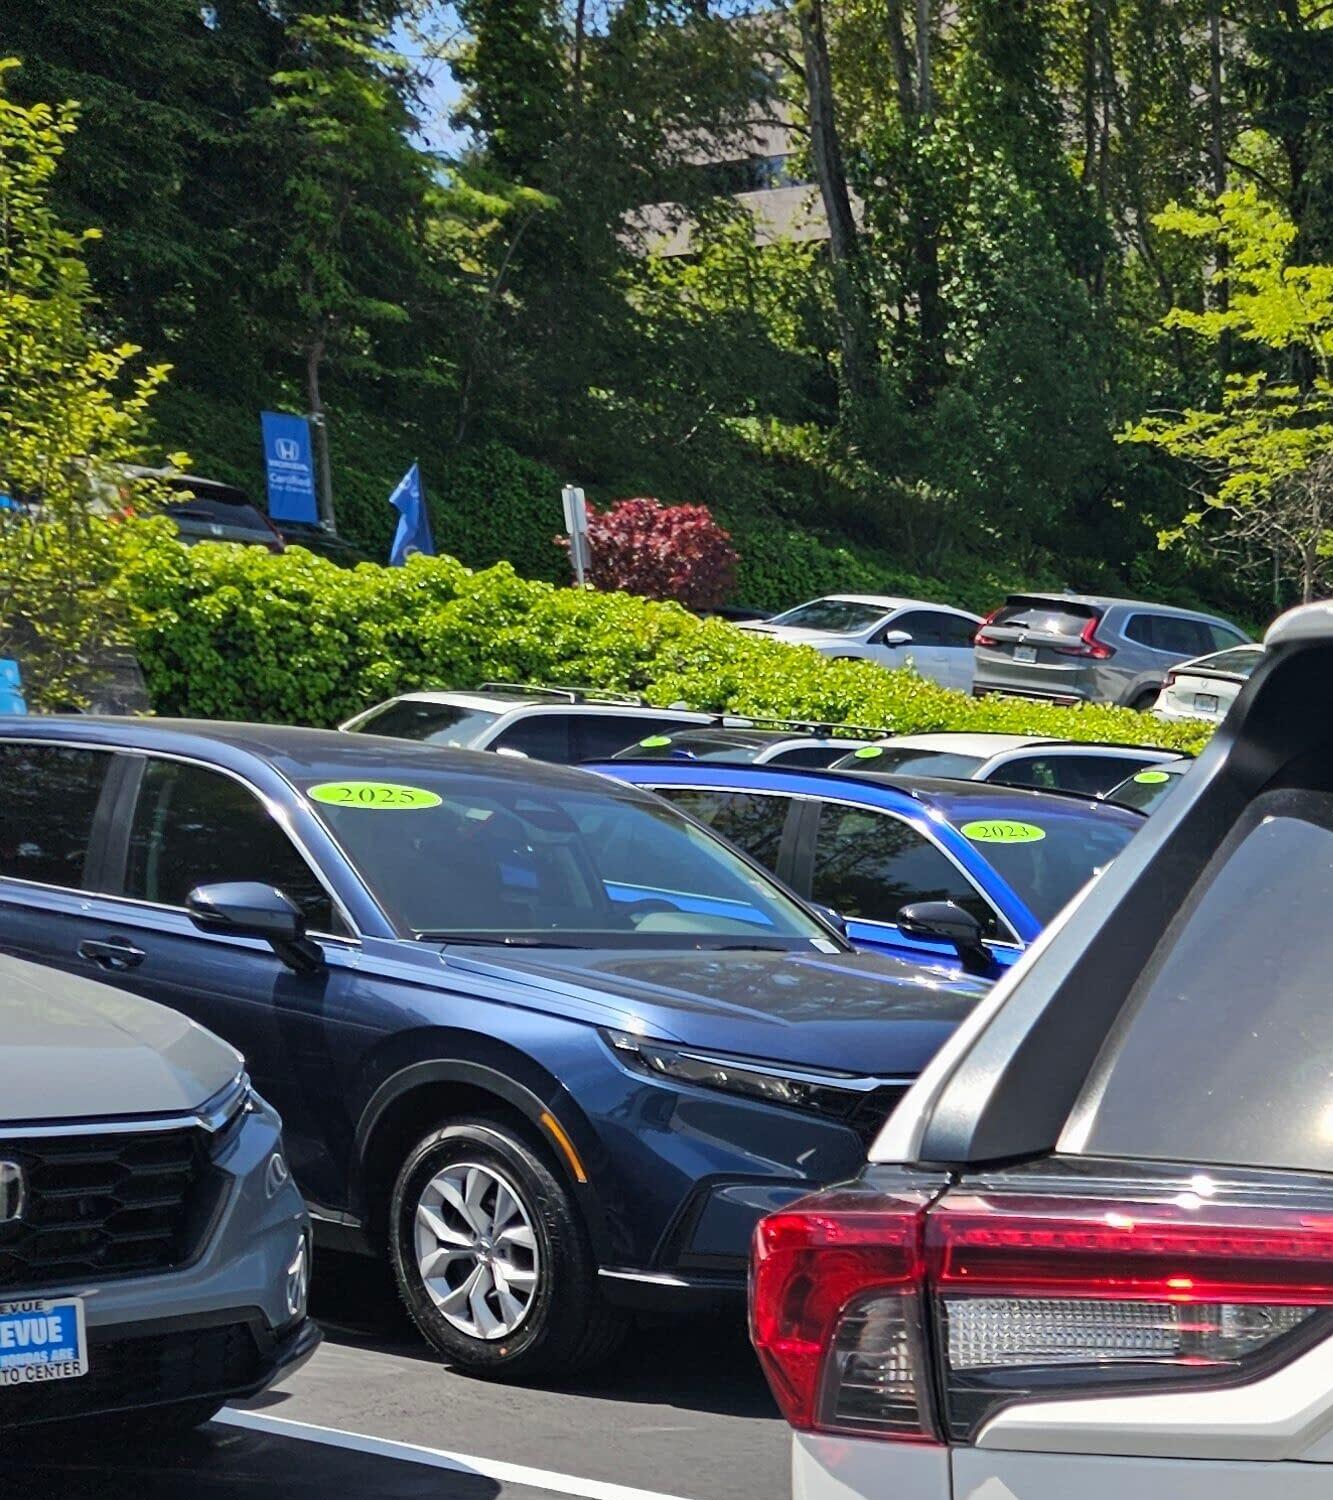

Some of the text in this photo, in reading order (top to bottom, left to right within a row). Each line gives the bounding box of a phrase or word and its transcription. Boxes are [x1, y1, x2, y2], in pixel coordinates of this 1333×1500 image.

[336, 788, 415, 803] 2025
[979, 825, 1029, 838] 2023
[50, 1348, 74, 1361] ARE
[25, 1361, 81, 1381] CENTER
